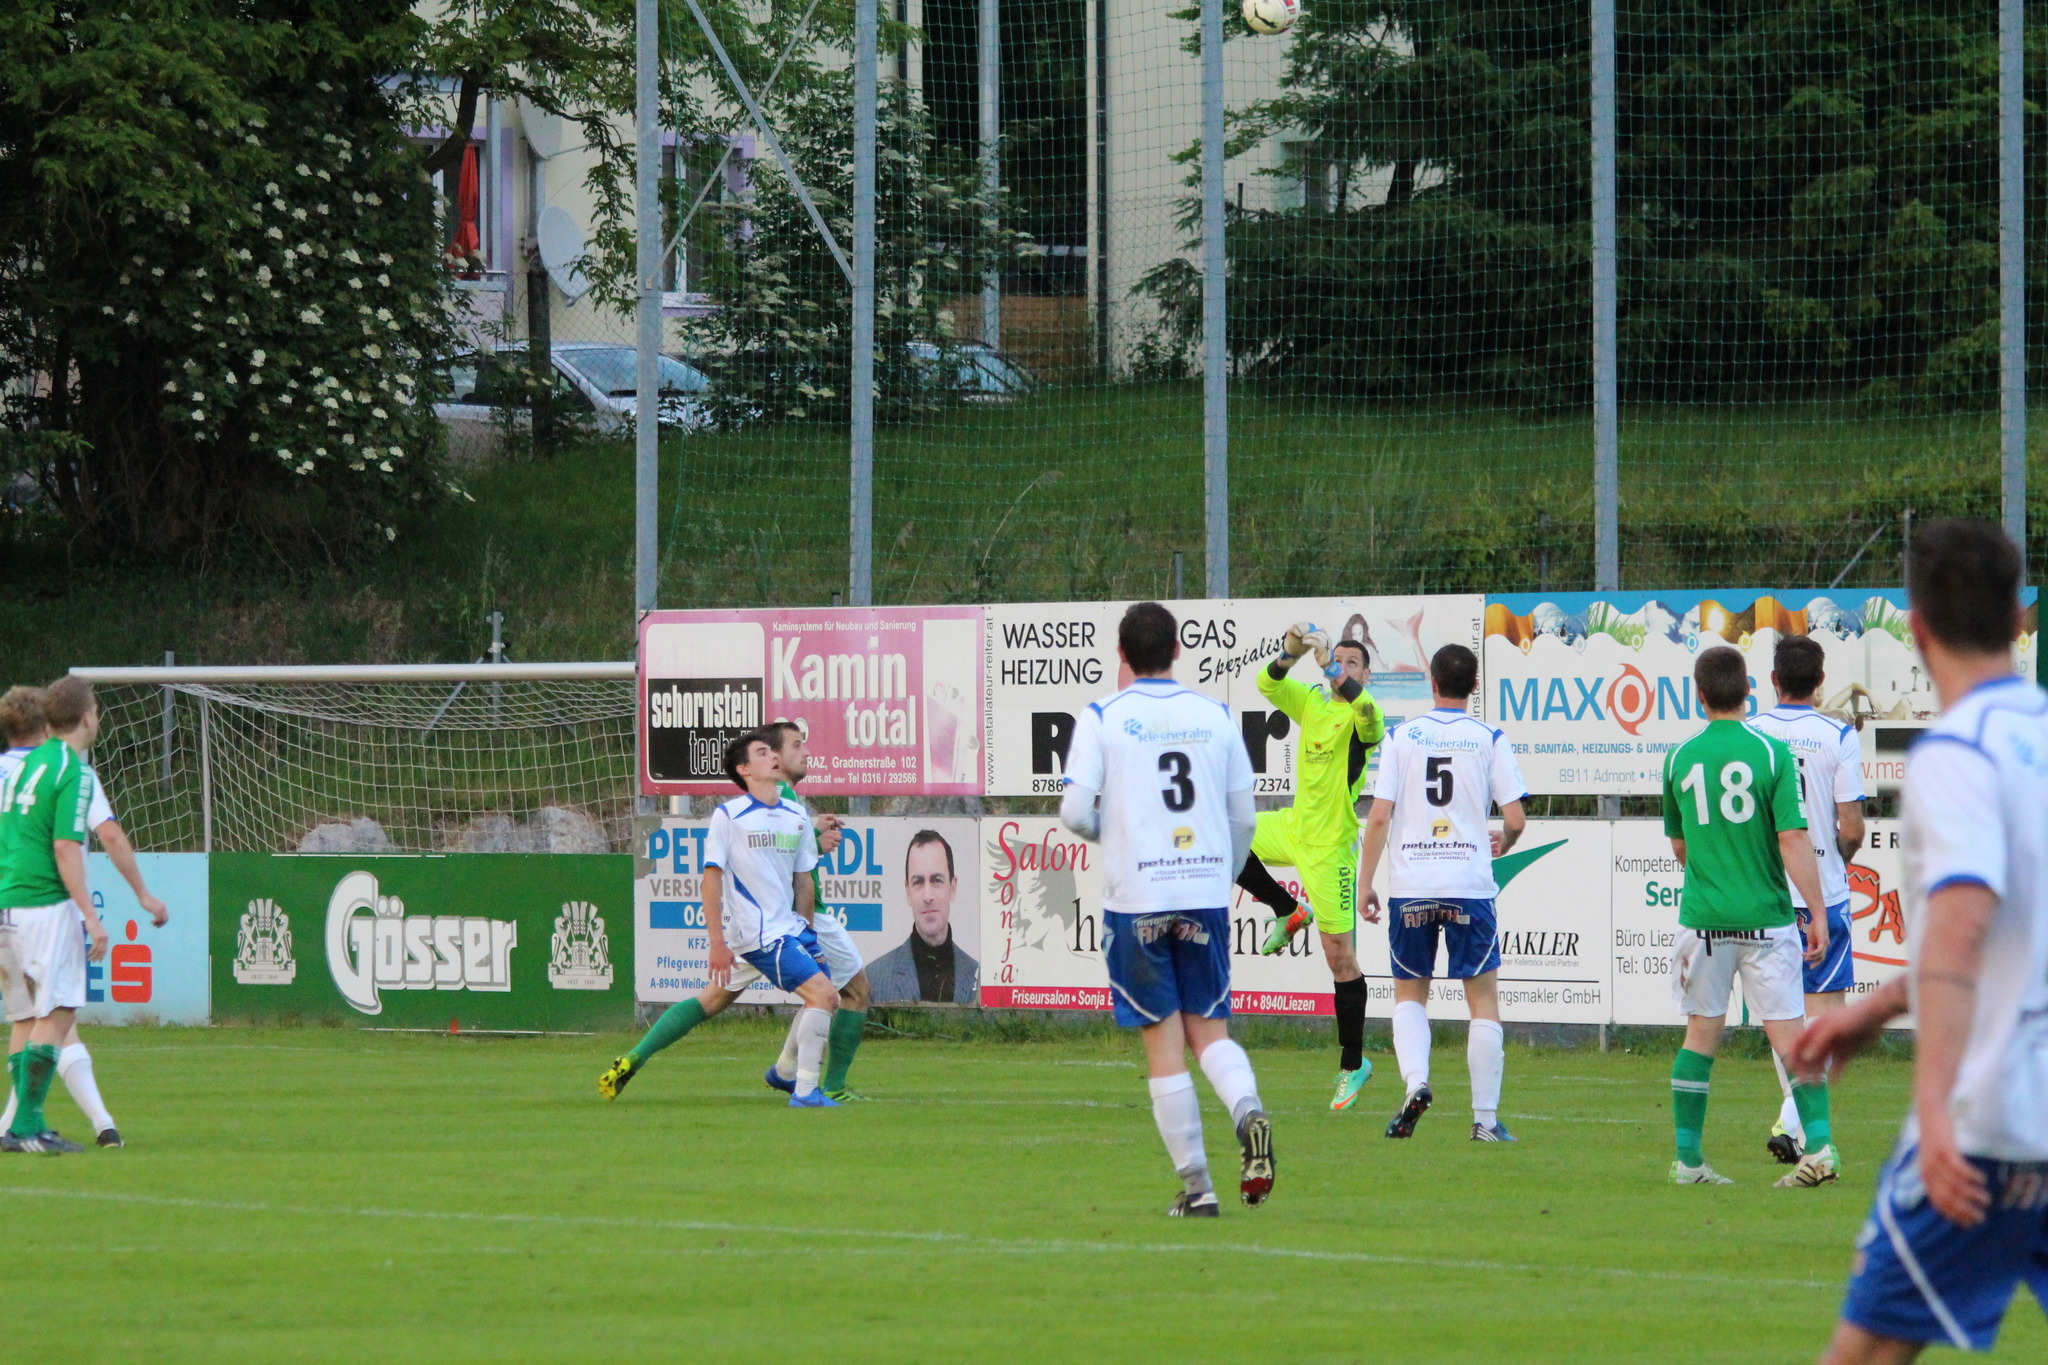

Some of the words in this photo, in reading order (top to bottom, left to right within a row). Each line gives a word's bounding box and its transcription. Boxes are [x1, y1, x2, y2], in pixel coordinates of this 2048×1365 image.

[772, 621, 823, 633] Kaminsysteme
[824, 621, 834, 631] für
[836, 621, 863, 631] Neubau
[864, 620, 878, 630] und
[880, 620, 916, 632] Sanierung
[1002, 622, 1096, 649] WASSER
[1180, 619, 1236, 649] GAS
[771, 636, 907, 702] Kamin
[1001, 657, 1103, 685] HEIZUNG
[651, 684, 759, 728] schornstein
[845, 695, 917, 748] total
[1582, 743, 1634, 754] HEIZUNGS-
[1636, 743, 1643, 753] &
[806, 756, 828, 770] RAZ,
[832, 756, 897, 769] Gradnerstraße
[901, 757, 917, 768] 102
[848, 773, 860, 784] Tel
[862, 773, 881, 784] 0316
[888, 773, 917, 784] 292566
[1158, 751, 1196, 814] 3
[1426, 757, 1454, 808] 5
[1559, 768, 1589, 783] 8911
[1593, 769, 1637, 783] Admont
[1032, 779, 1064, 793] 8786
[1681, 761, 1756, 826] 18
[993, 821, 1090, 881] Salon
[325, 870, 518, 1016] Gösser
[1615, 929, 1646, 947] Büro
[1650, 930, 1675, 947] Liez
[657, 957, 709, 971] Pflegevers
[1615, 956, 1638, 974] Tel:
[650, 978, 680, 988] A-8940
[1011, 989, 1070, 1005] Friseursalon
[1077, 990, 1105, 1009] Sonja
[1562, 988, 1601, 1004] GmbH
